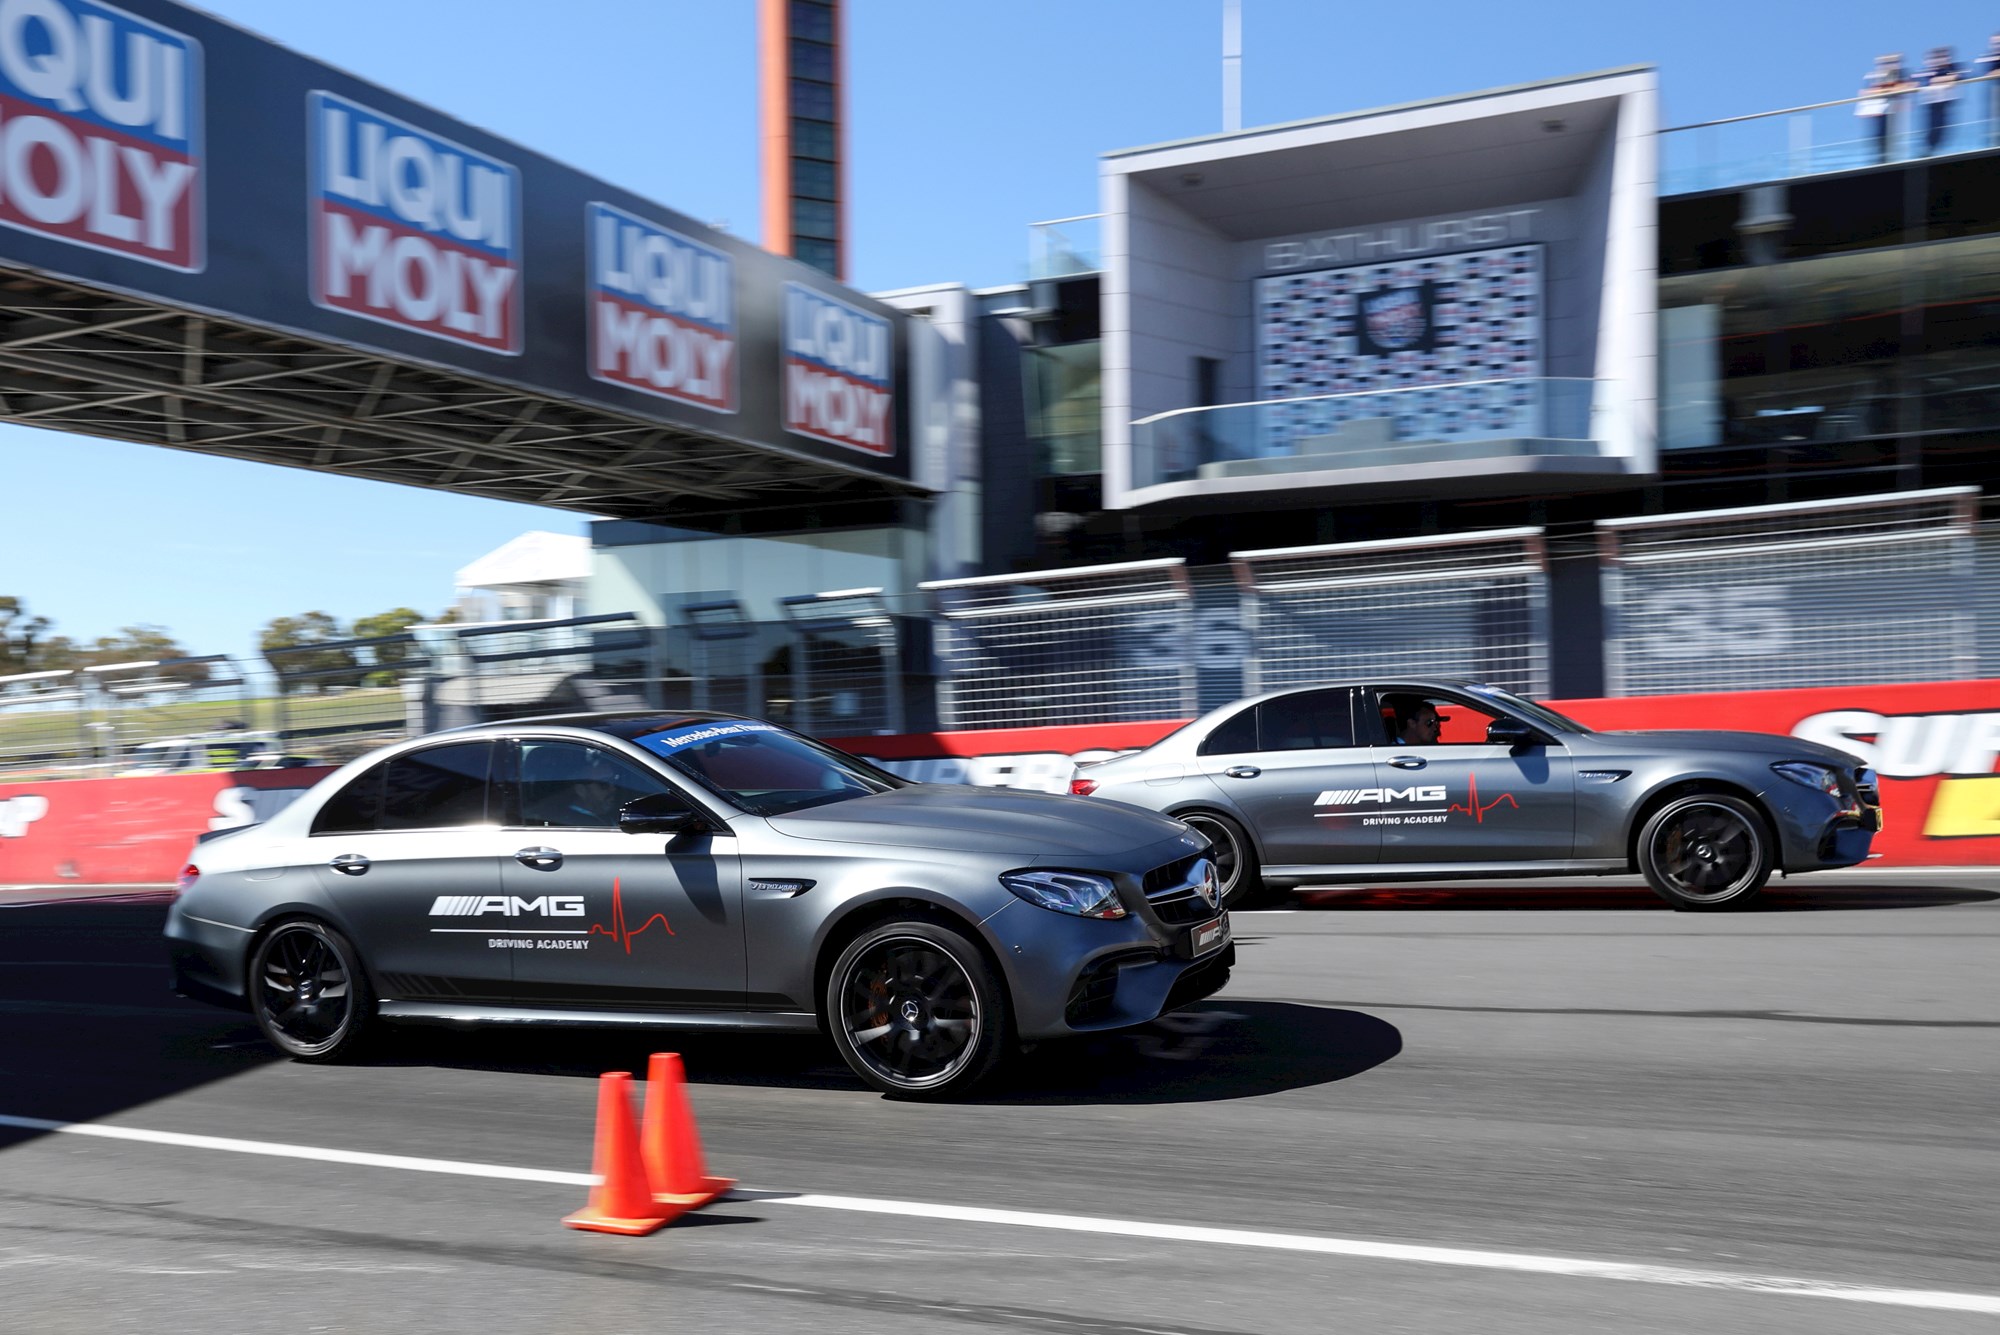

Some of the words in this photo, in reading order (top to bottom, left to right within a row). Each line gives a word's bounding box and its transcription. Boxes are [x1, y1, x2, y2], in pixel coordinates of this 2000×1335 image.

[0, 115, 198, 251] OLY
[322, 108, 511, 249] LIQUI
[324, 211, 518, 338] MOLY
[594, 215, 732, 325] LIQUI
[1264, 209, 1542, 270] BATHURST
[595, 300, 735, 401] MOLY
[784, 290, 891, 381] LIQUI
[784, 363, 892, 446] MOLY
[1362, 817, 1401, 826] DRIVING
[1403, 815, 1448, 824] ACADEMY
[488, 938, 534, 949] DRIVING
[536, 939, 590, 950] ACADEMY
